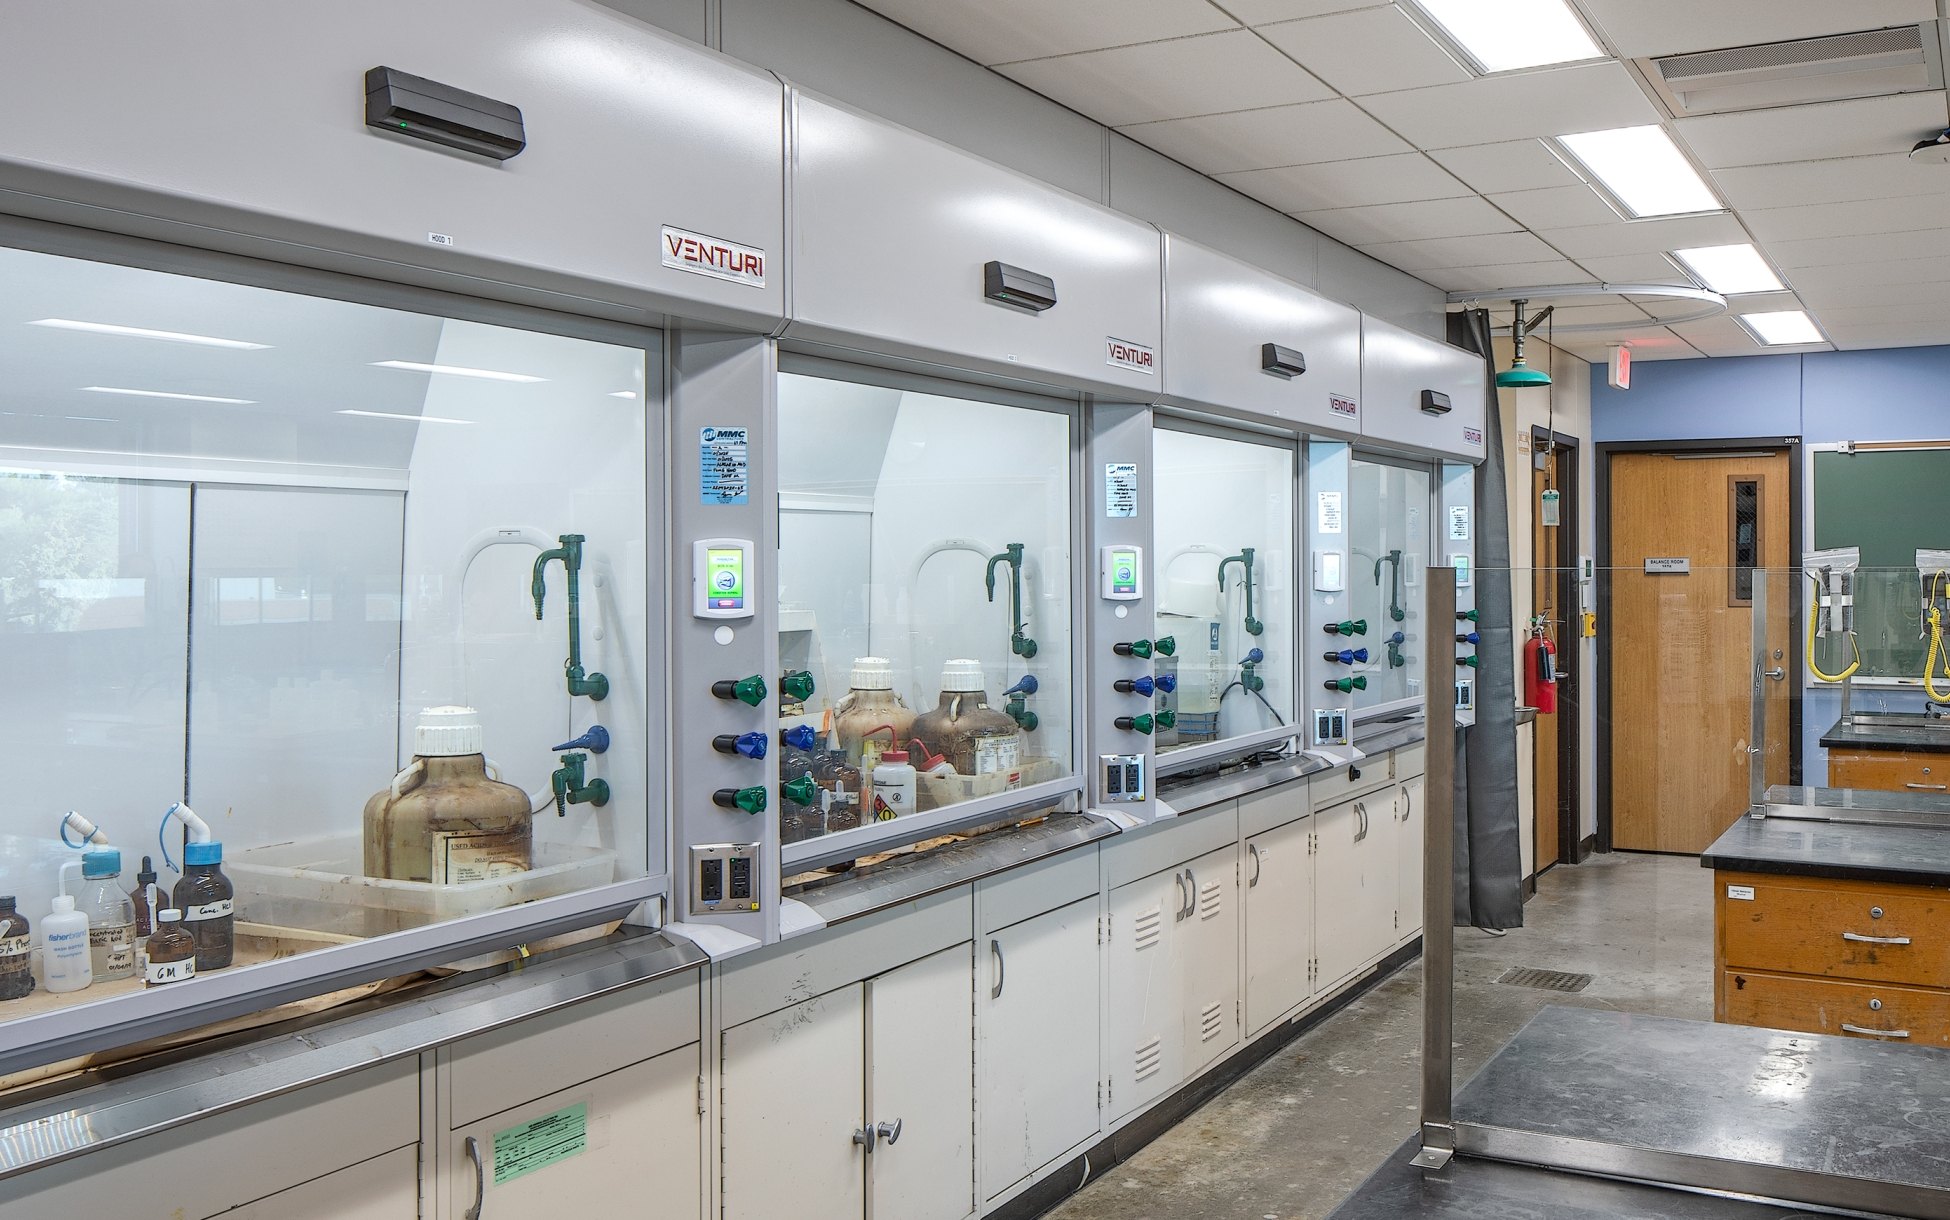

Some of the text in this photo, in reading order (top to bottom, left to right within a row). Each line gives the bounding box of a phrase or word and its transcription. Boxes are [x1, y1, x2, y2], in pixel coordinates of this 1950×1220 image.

[431, 234, 446, 244] HOOD
[665, 234, 763, 277] VENTURI
[1108, 342, 1153, 367] VENTURI
[1329, 398, 1356, 414] VENTURI
[1463, 430, 1481, 442] VENTURI
[48, 929, 87, 942] fisherbrand
